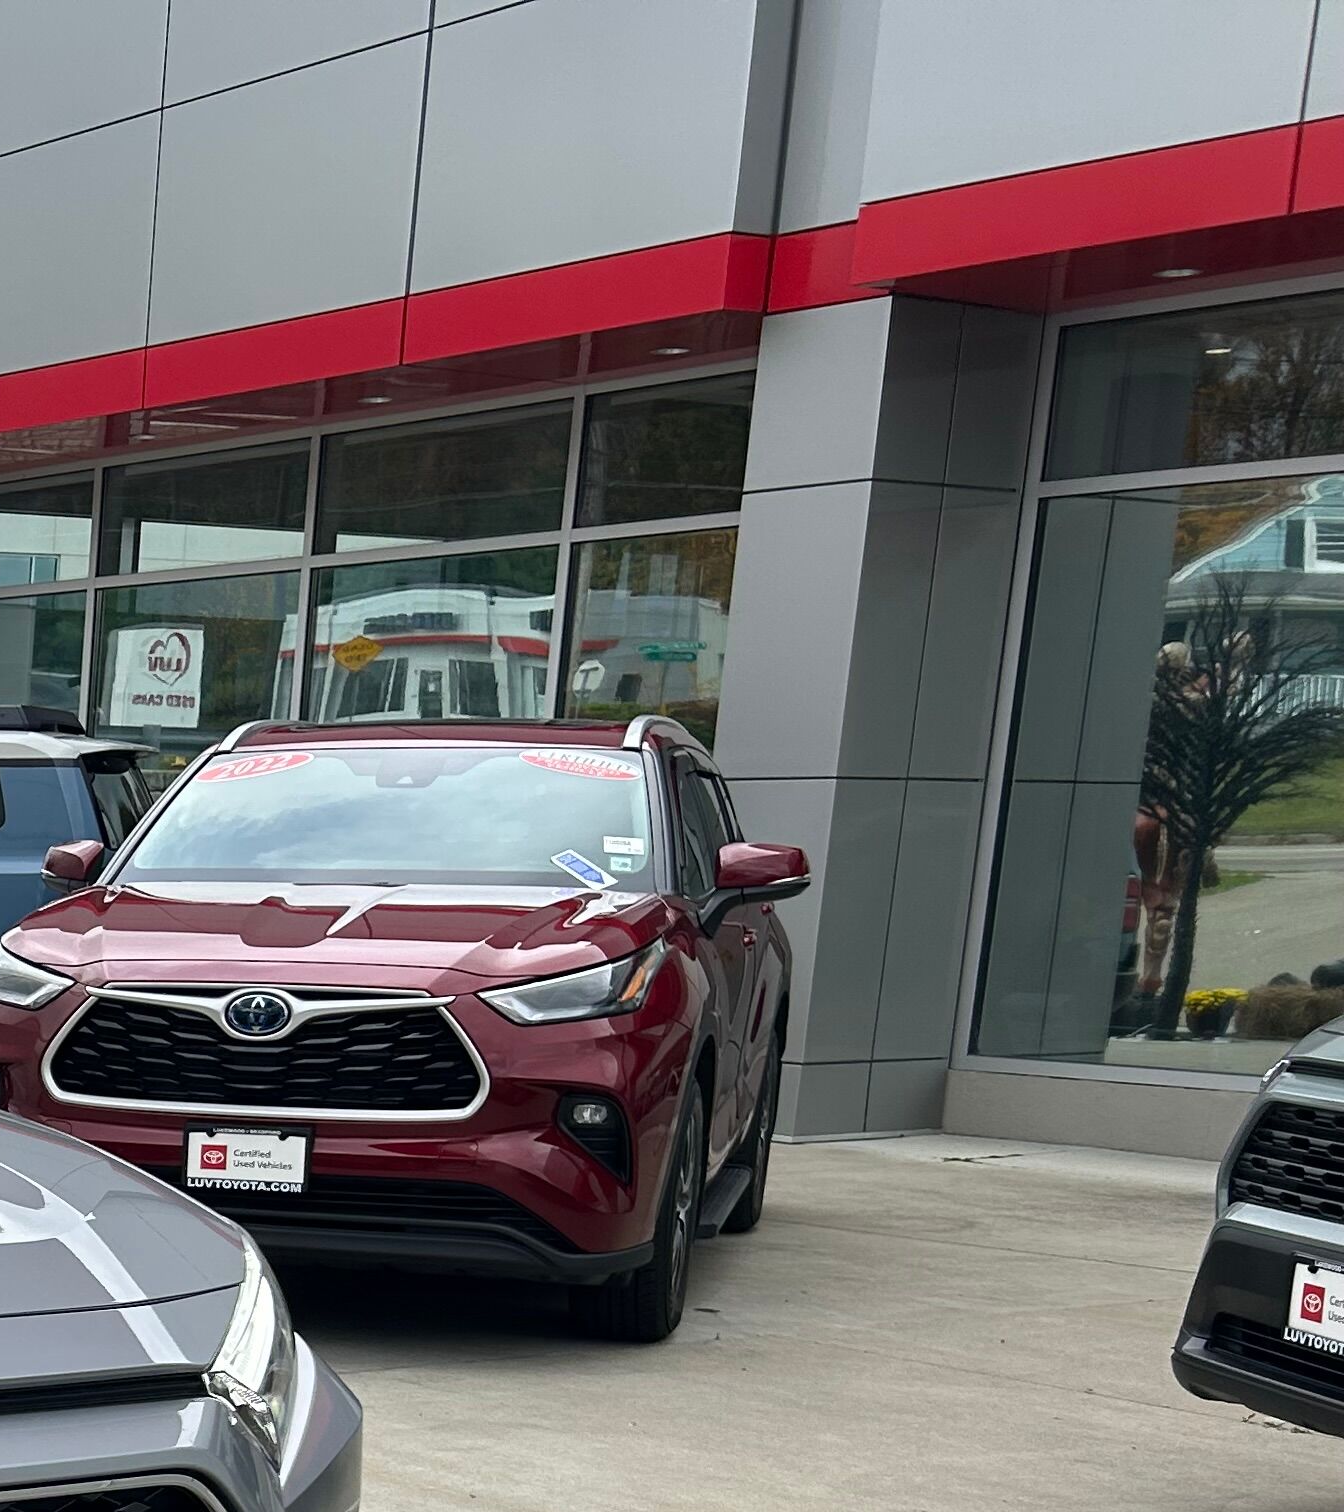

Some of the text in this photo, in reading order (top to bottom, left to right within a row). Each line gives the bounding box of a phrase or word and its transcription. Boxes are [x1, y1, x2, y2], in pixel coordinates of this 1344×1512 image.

[213, 753, 294, 779] 2022
[233, 1149, 272, 1159] Certified
[233, 1160, 293, 1171] Used Vehicles
[187, 1178, 302, 1193] LUVTOYOTA.COM
